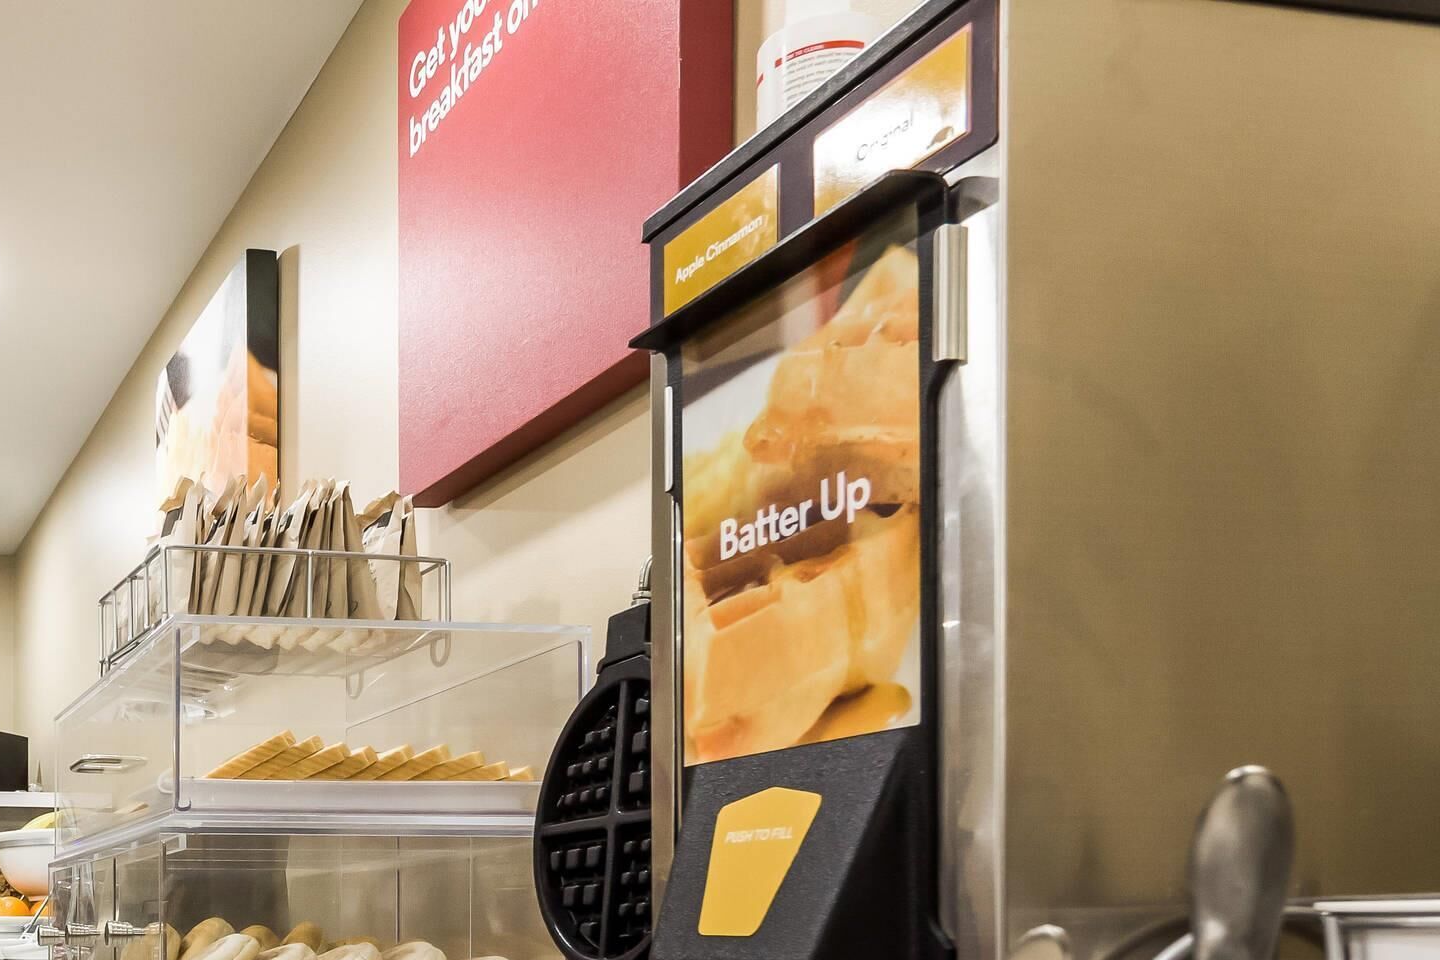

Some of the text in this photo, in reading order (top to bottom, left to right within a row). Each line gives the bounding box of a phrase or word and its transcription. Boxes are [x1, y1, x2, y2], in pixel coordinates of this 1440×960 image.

[409, 0, 491, 98] Get you
[409, 11, 503, 158] breakfast
[675, 215, 764, 285] Apple Cinnamon
[720, 471, 871, 561] Batter Up
[724, 830, 752, 844] PUSH
[753, 828, 770, 841] TO
